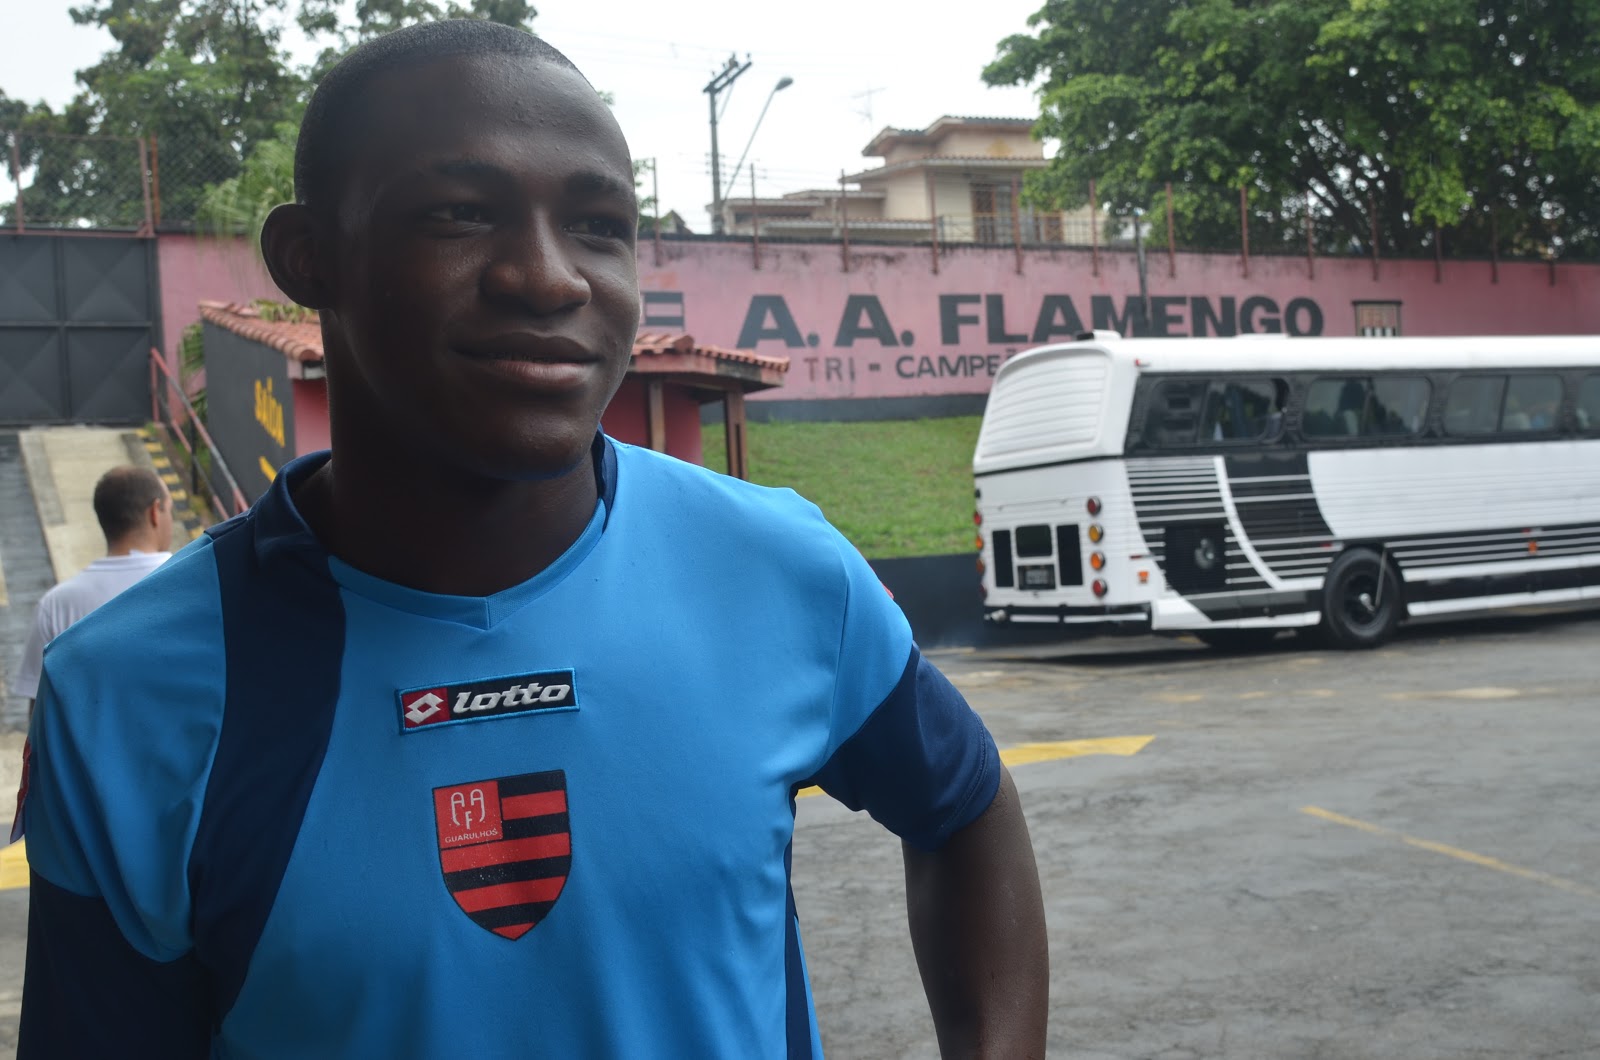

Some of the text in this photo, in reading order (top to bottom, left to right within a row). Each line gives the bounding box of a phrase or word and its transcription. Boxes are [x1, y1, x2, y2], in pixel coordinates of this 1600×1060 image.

[938, 293, 1323, 345] FLAMENGO
[804, 357, 855, 382] TRI
[453, 682, 571, 714] lotto
[444, 828, 499, 844] GUARULHOS
